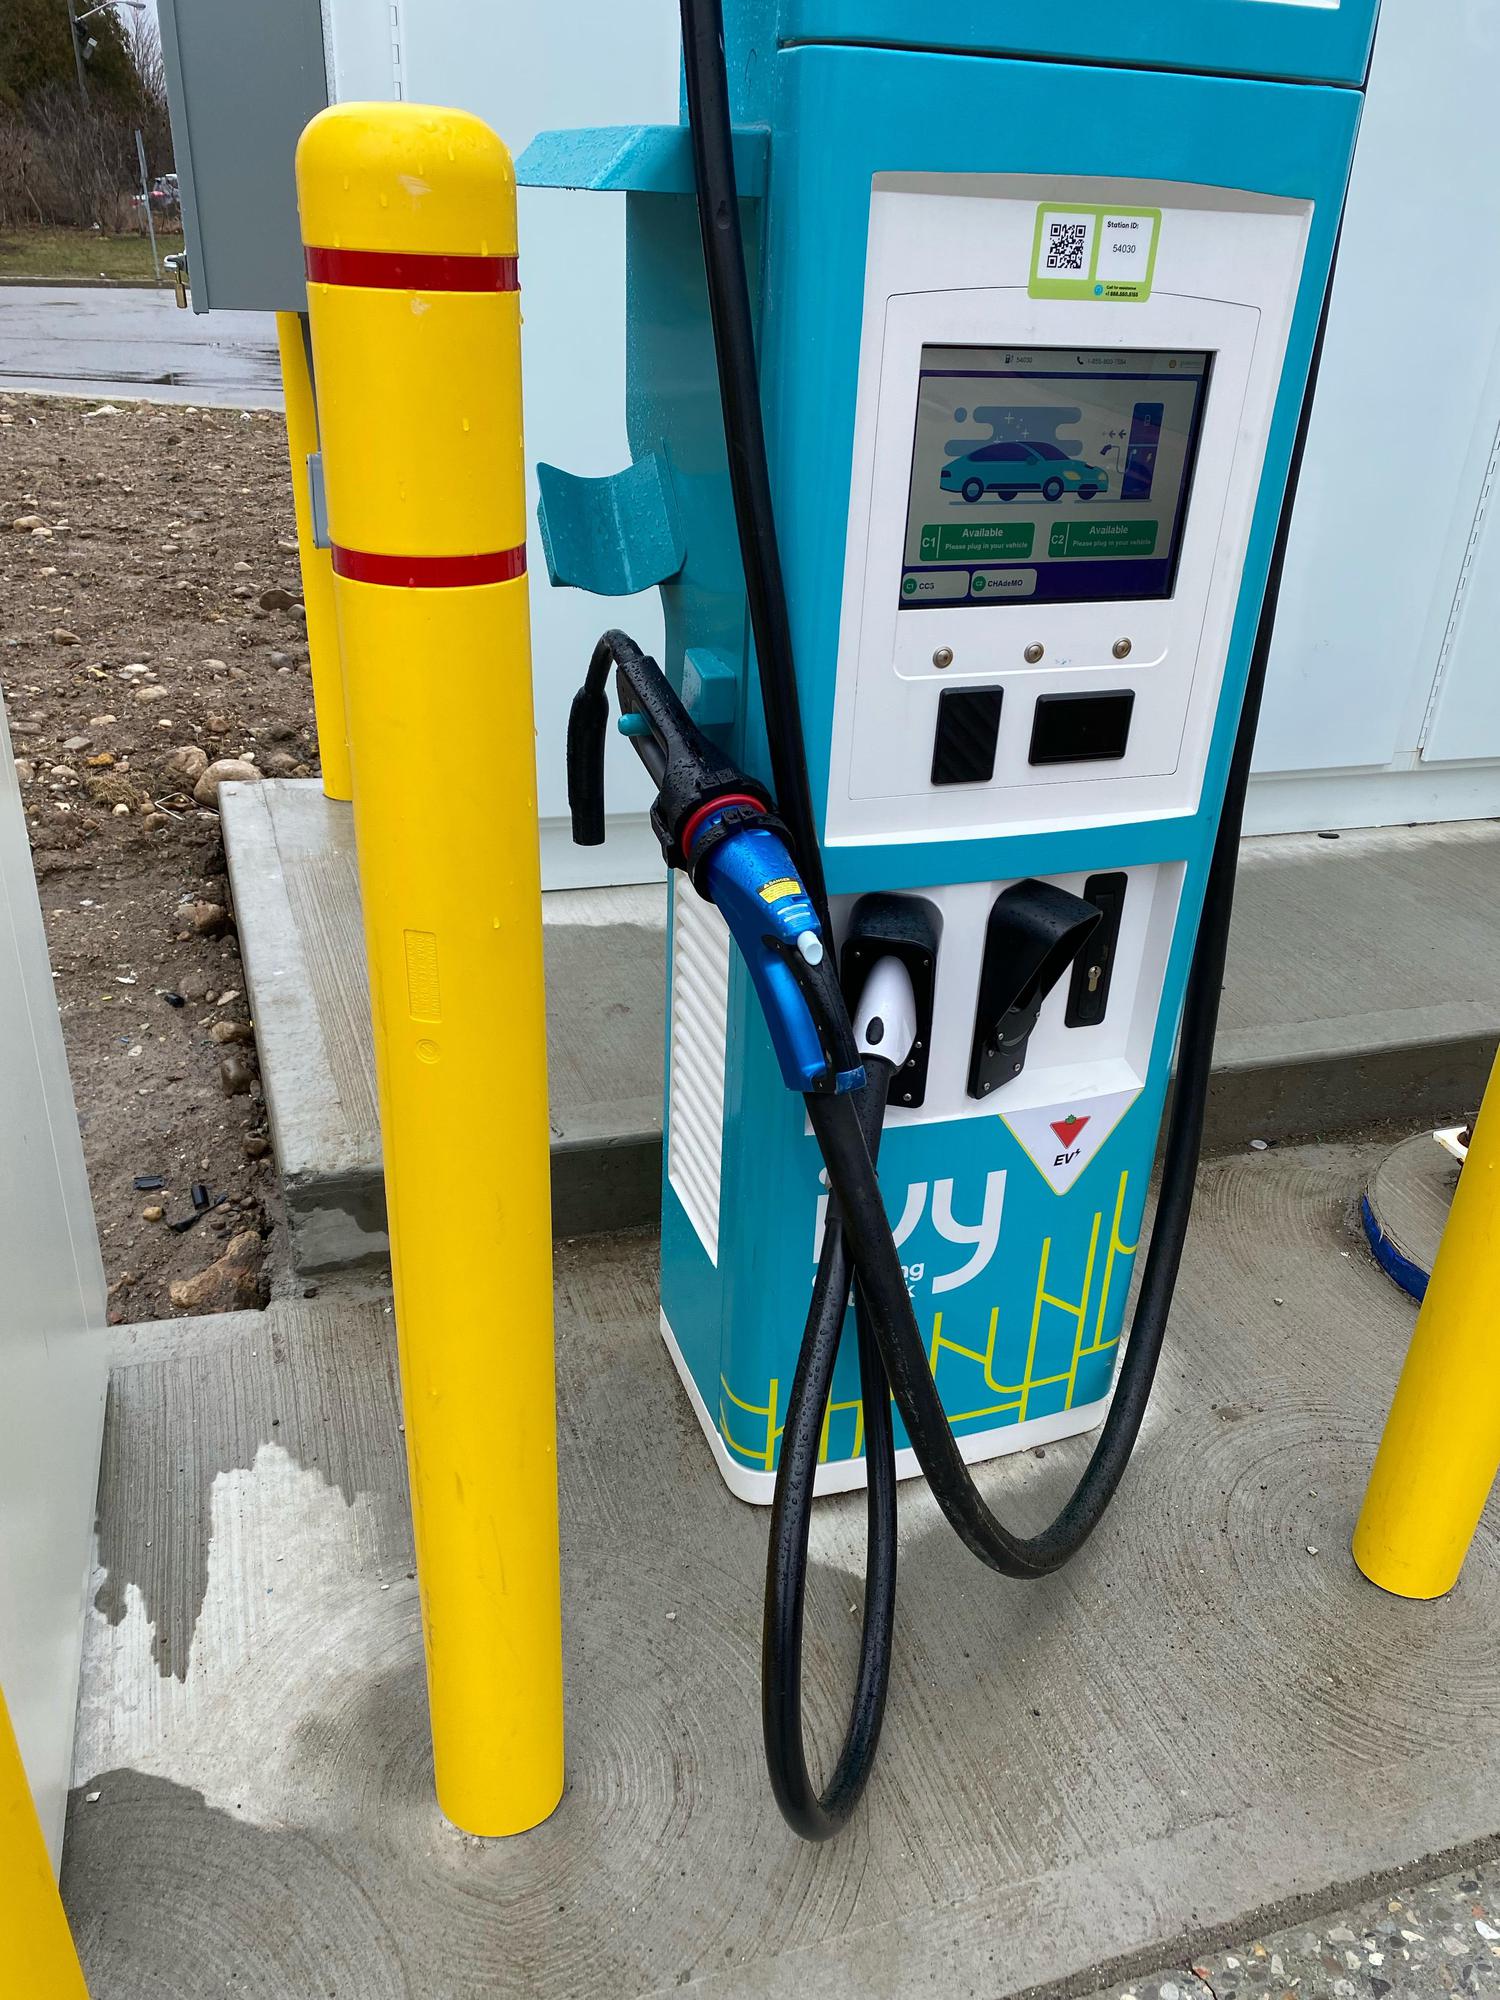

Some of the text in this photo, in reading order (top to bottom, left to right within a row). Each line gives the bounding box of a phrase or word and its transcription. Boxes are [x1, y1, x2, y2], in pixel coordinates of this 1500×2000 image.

[1107, 220, 1139, 230] Station ID:
[1112, 243, 1136, 254] 54030
[1016, 356, 1033, 364] 54030
[962, 528, 1004, 538] Available
[1089, 524, 1129, 535] Available
[922, 537, 936, 548] C1
[1051, 534, 1064, 545] C2
[1072, 539, 1093, 547] Please
[1093, 540, 1107, 548] plug
[1115, 539, 1129, 547] your
[1129, 537, 1152, 545] vehicle
[967, 543, 981, 551] plug
[990, 542, 1005, 550] your
[1005, 541, 1028, 549] vehicle
[987, 579, 1024, 588] CHAdeMO
